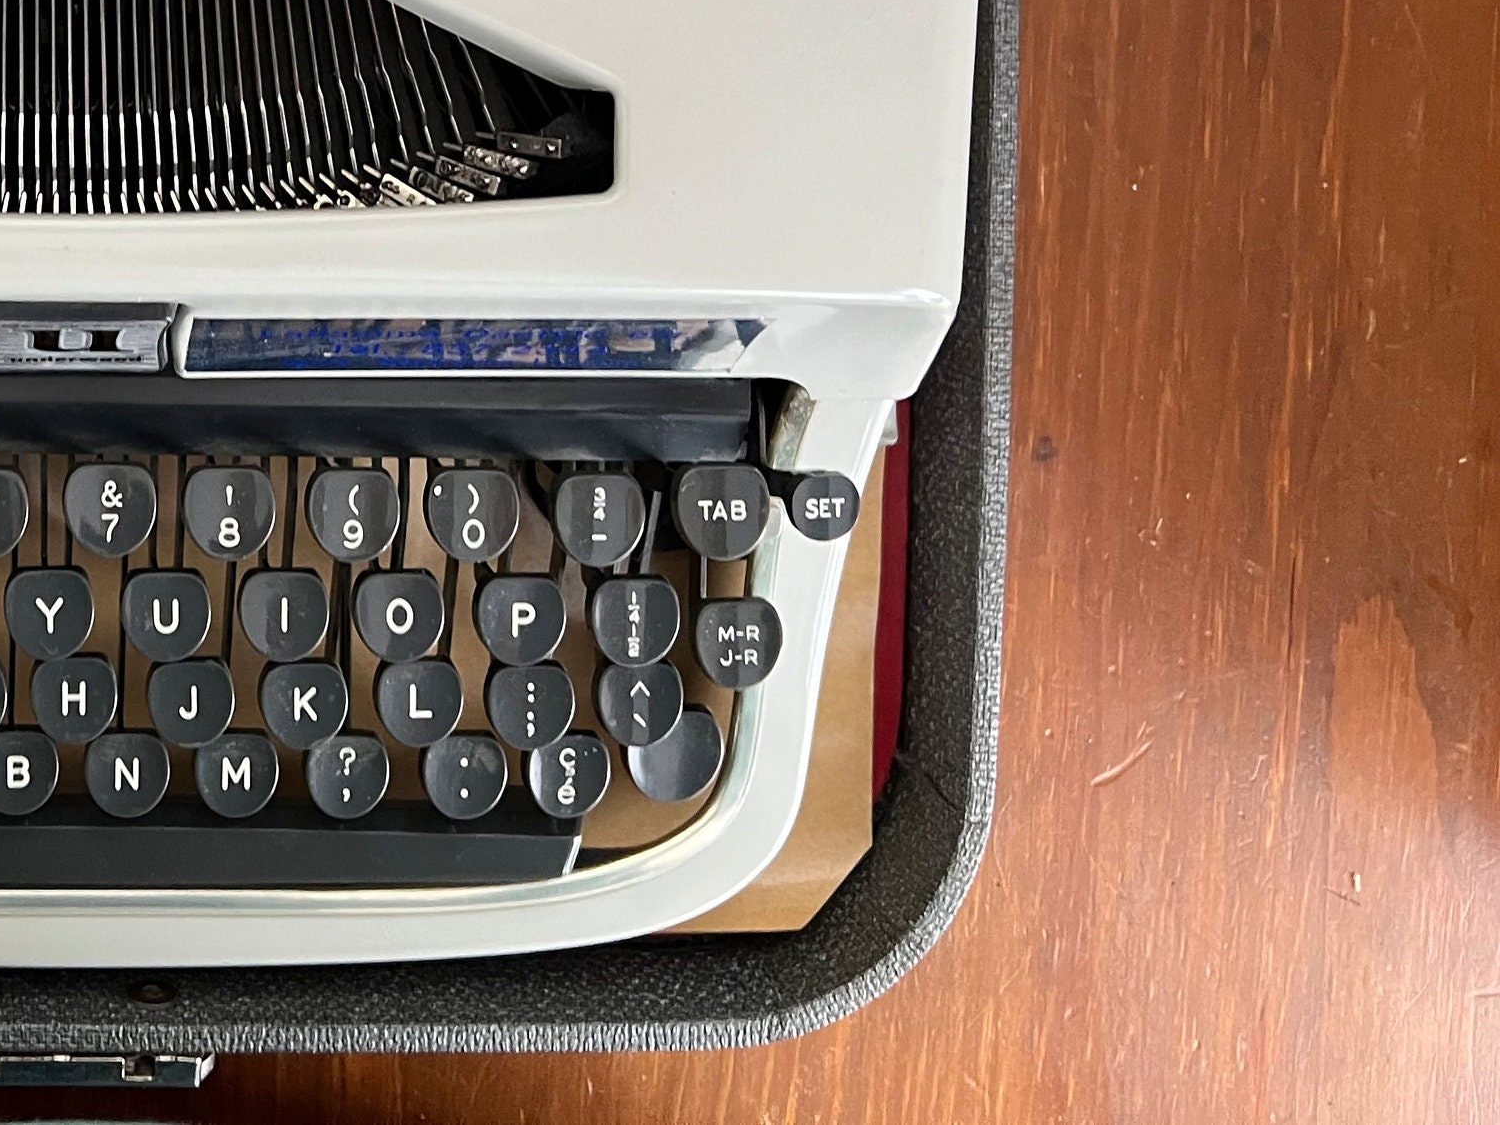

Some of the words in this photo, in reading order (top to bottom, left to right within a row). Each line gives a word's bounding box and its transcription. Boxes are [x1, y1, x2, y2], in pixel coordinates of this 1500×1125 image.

[101, 480, 123, 508] &
[348, 484, 360, 517] (
[467, 483, 480, 515] )
[697, 499, 747, 521] TAB
[804, 497, 846, 520] SET
[101, 513, 120, 543] 7
[218, 517, 241, 548] 8
[342, 519, 364, 550] 9
[462, 518, 486, 550] 0
[35, 597, 64, 634] Y
[153, 598, 179, 635] U
[281, 597, 288, 633] I
[385, 597, 414, 635] O
[511, 602, 536, 638] P
[61, 680, 87, 717] H
[178, 685, 198, 720] J
[293, 686, 318, 722] K
[408, 683, 433, 719] L
[6, 755, 31, 789] B
[114, 757, 140, 791] N
[221, 756, 251, 791] M
